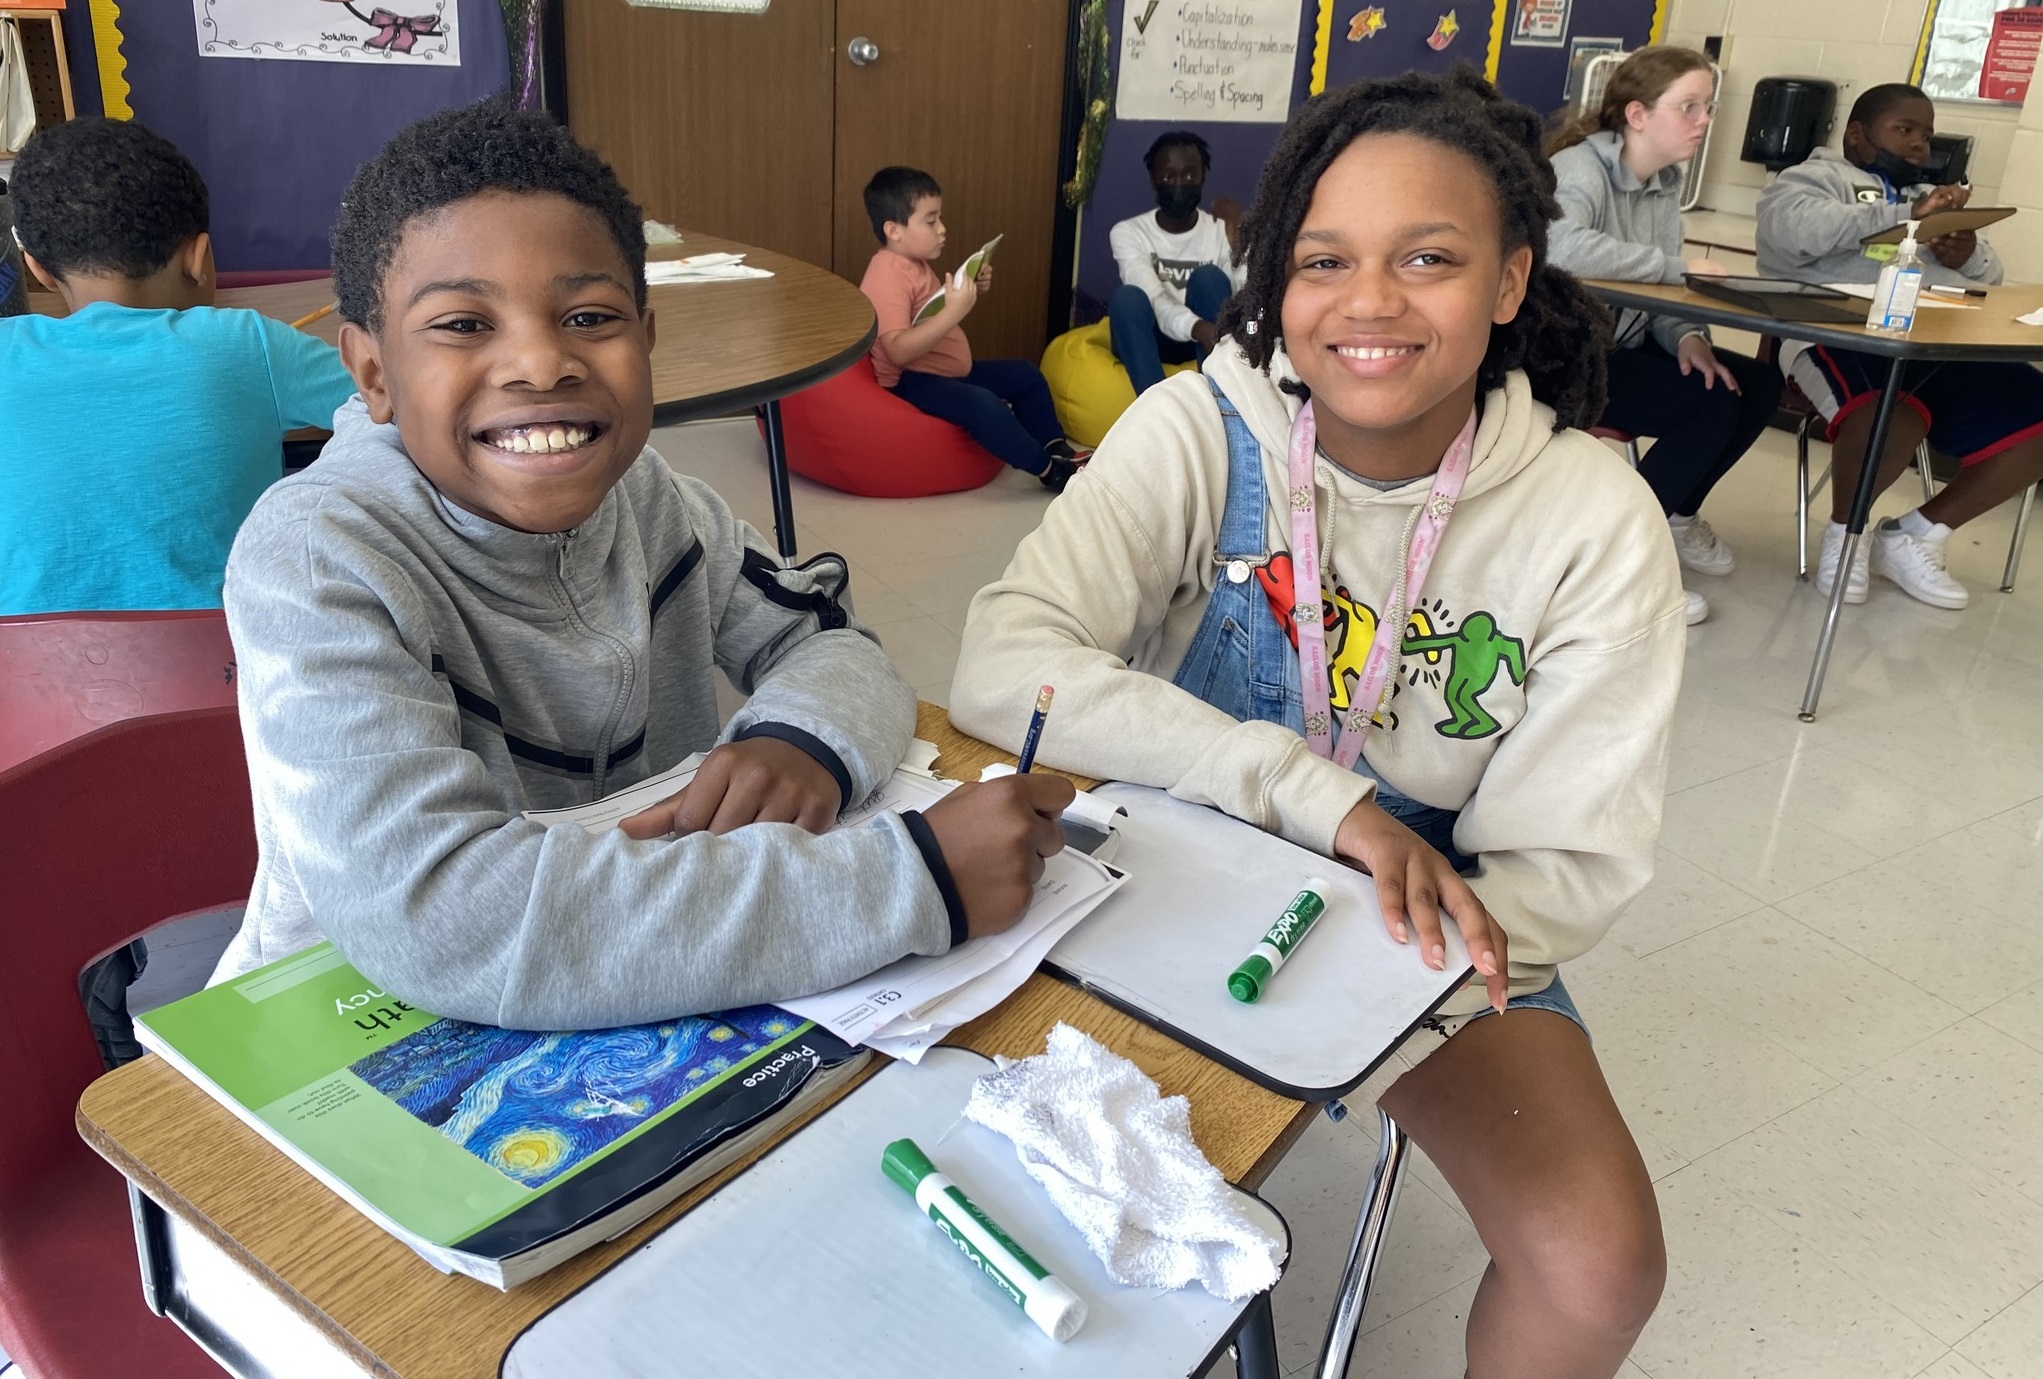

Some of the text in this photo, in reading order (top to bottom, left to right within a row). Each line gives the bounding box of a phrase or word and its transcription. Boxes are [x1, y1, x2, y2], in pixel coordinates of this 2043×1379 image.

[1182, 2, 1253, 26] Capitalization
[320, 32, 358, 42] Solution
[1179, 55, 1235, 75] Punctuation
[1174, 80, 1216, 108] Spelling
[1227, 82, 1264, 111] Spacing
[1416, 538, 1426, 558] MOON
[1364, 646, 1384, 691] SAILOR MOON
[1267, 911, 1299, 946] EXPO
[336, 989, 386, 1016] ncy
[742, 1044, 817, 1088] Practice
[320, 1083, 334, 1091] find
[331, 1083, 347, 1091] Turn
[337, 1086, 350, 1094] with
[303, 1097, 320, 1105] book
[330, 1089, 355, 1103] painting
[344, 1094, 361, 1103] What
[288, 1105, 302, 1113] over
[315, 1103, 330, 1111] have
[328, 1102, 343, 1111] does
